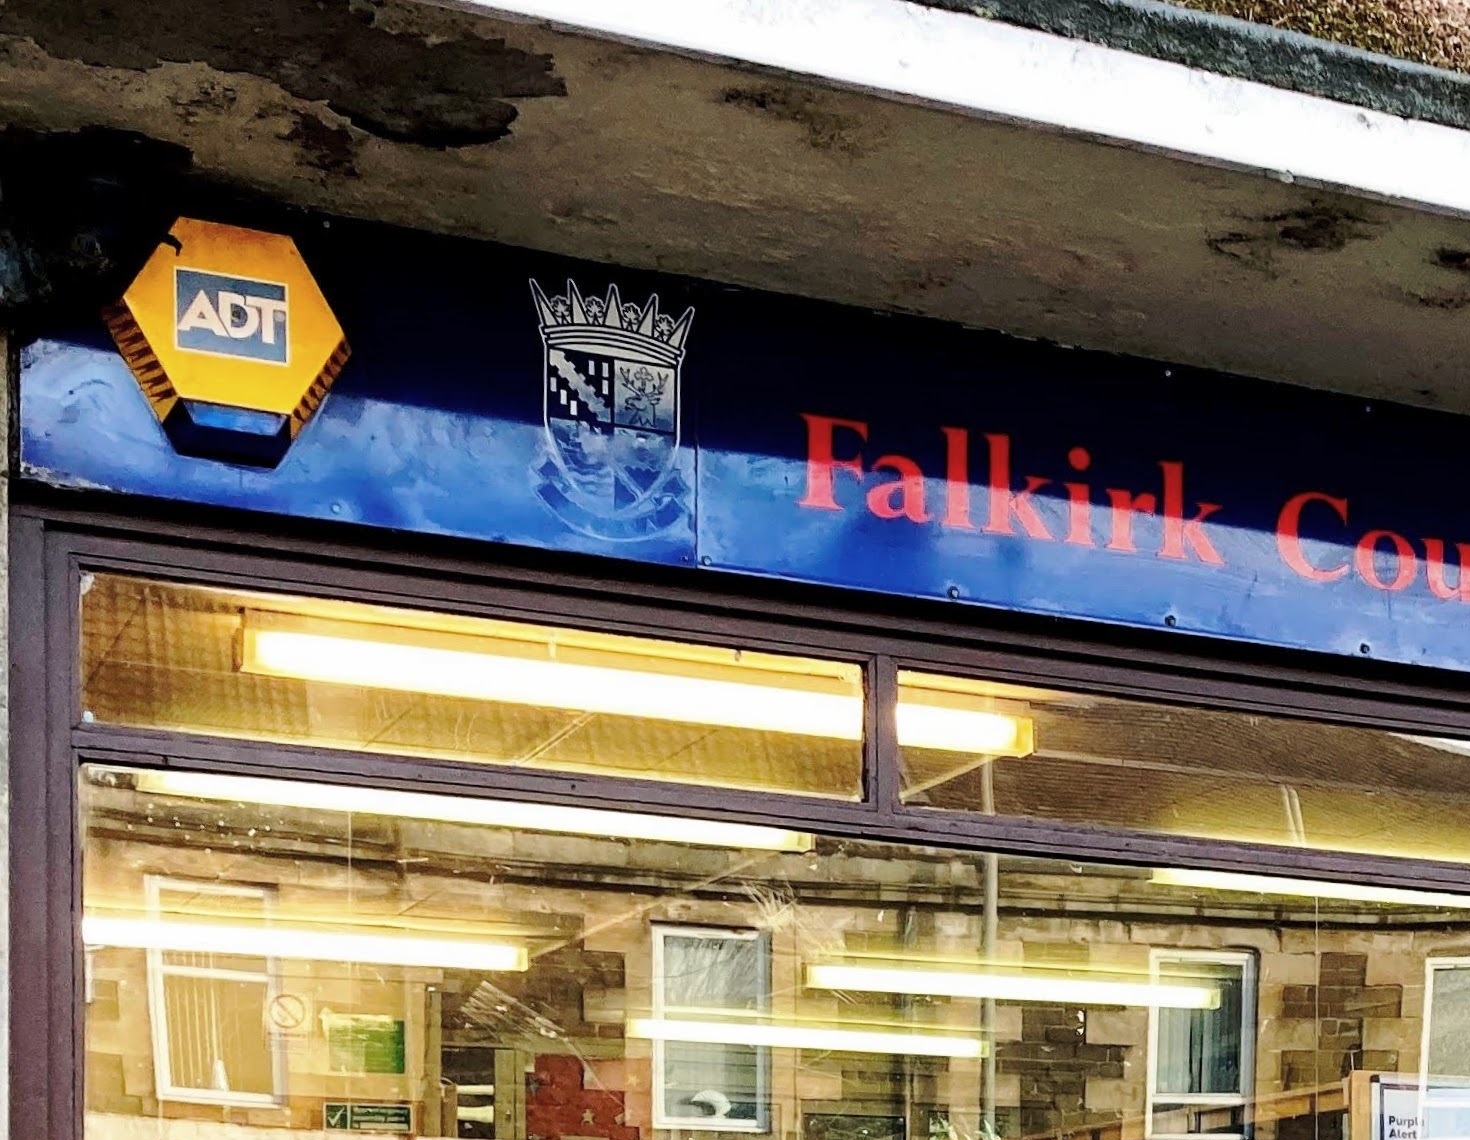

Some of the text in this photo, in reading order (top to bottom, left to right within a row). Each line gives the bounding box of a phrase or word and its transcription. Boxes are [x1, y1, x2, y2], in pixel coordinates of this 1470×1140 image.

[177, 288, 286, 347] ADT
[798, 413, 1224, 567] Falkirk
[1388, 1129, 1417, 1139] Alert
